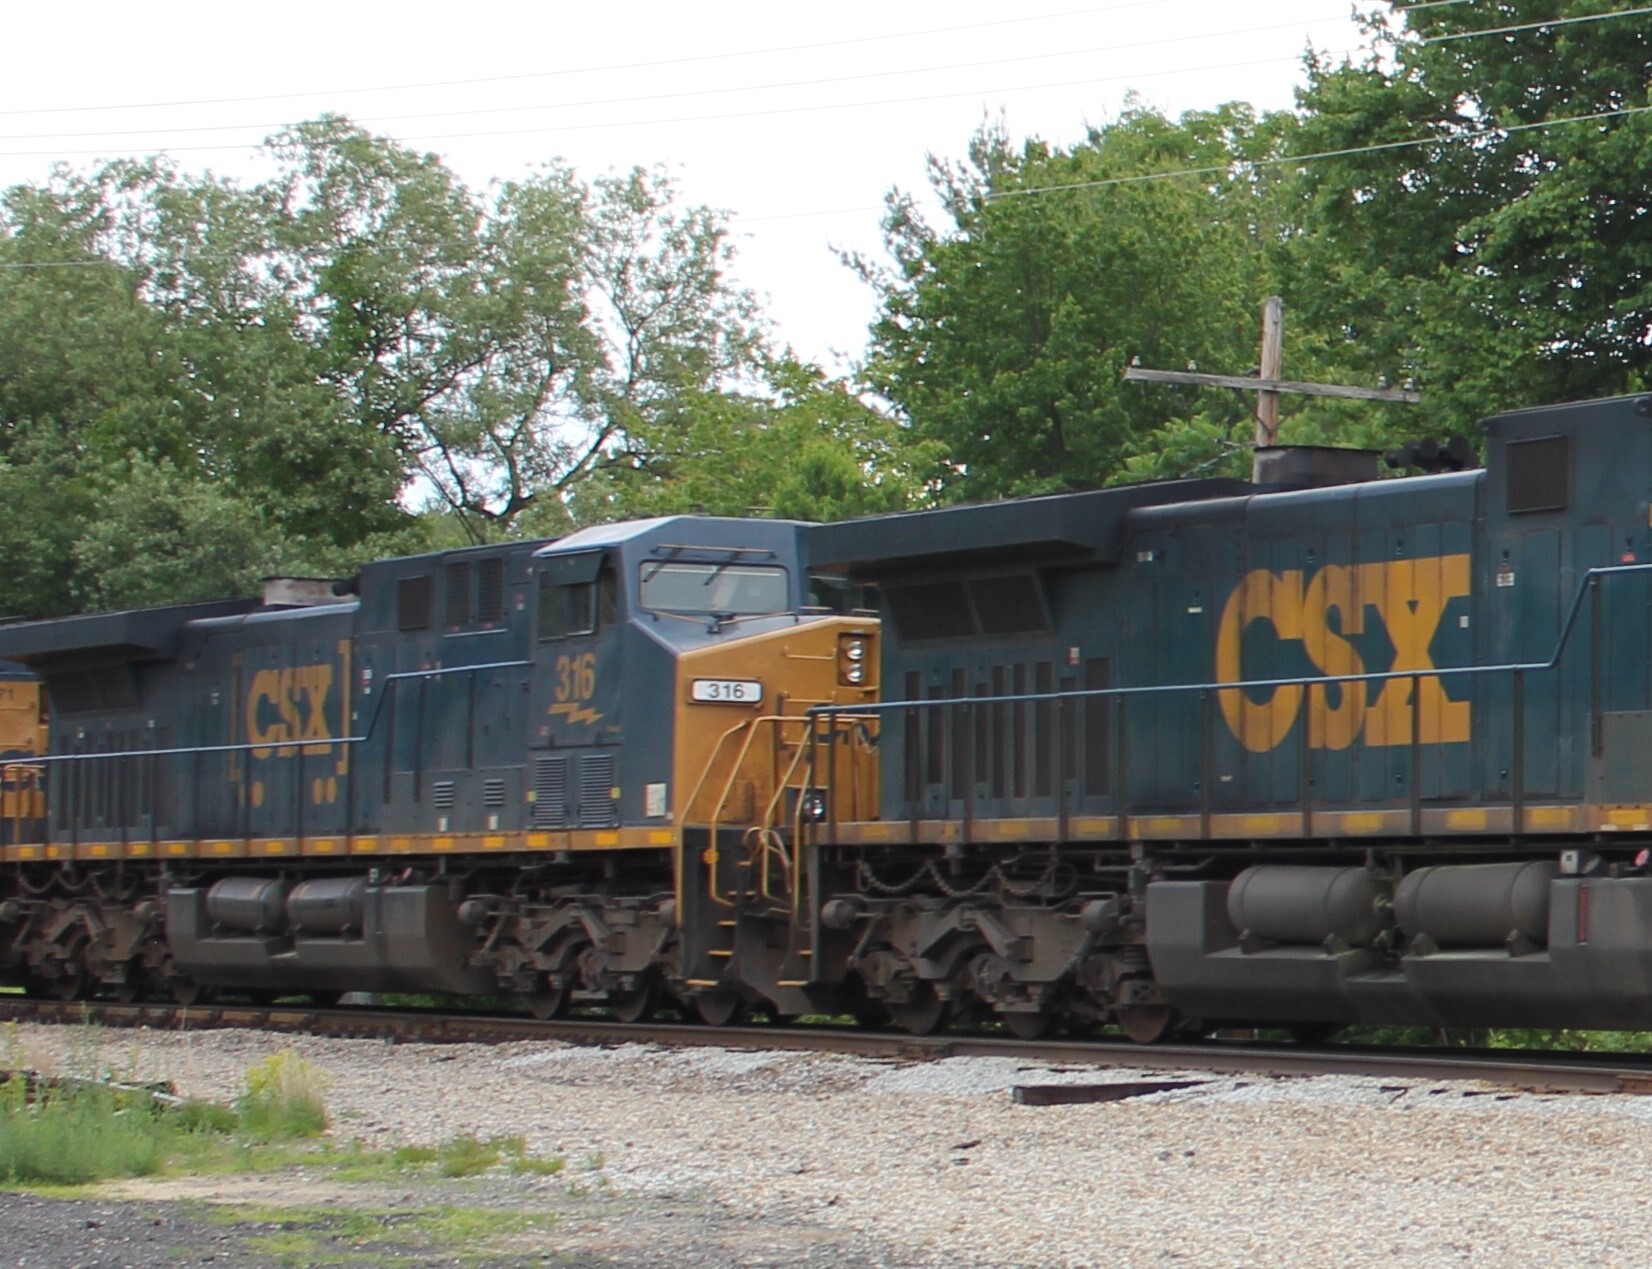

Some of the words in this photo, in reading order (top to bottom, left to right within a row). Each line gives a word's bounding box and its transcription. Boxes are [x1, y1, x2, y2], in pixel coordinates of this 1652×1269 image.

[555, 651, 596, 701] 316
[1216, 553, 1471, 753] CSX
[708, 683, 745, 699] 316
